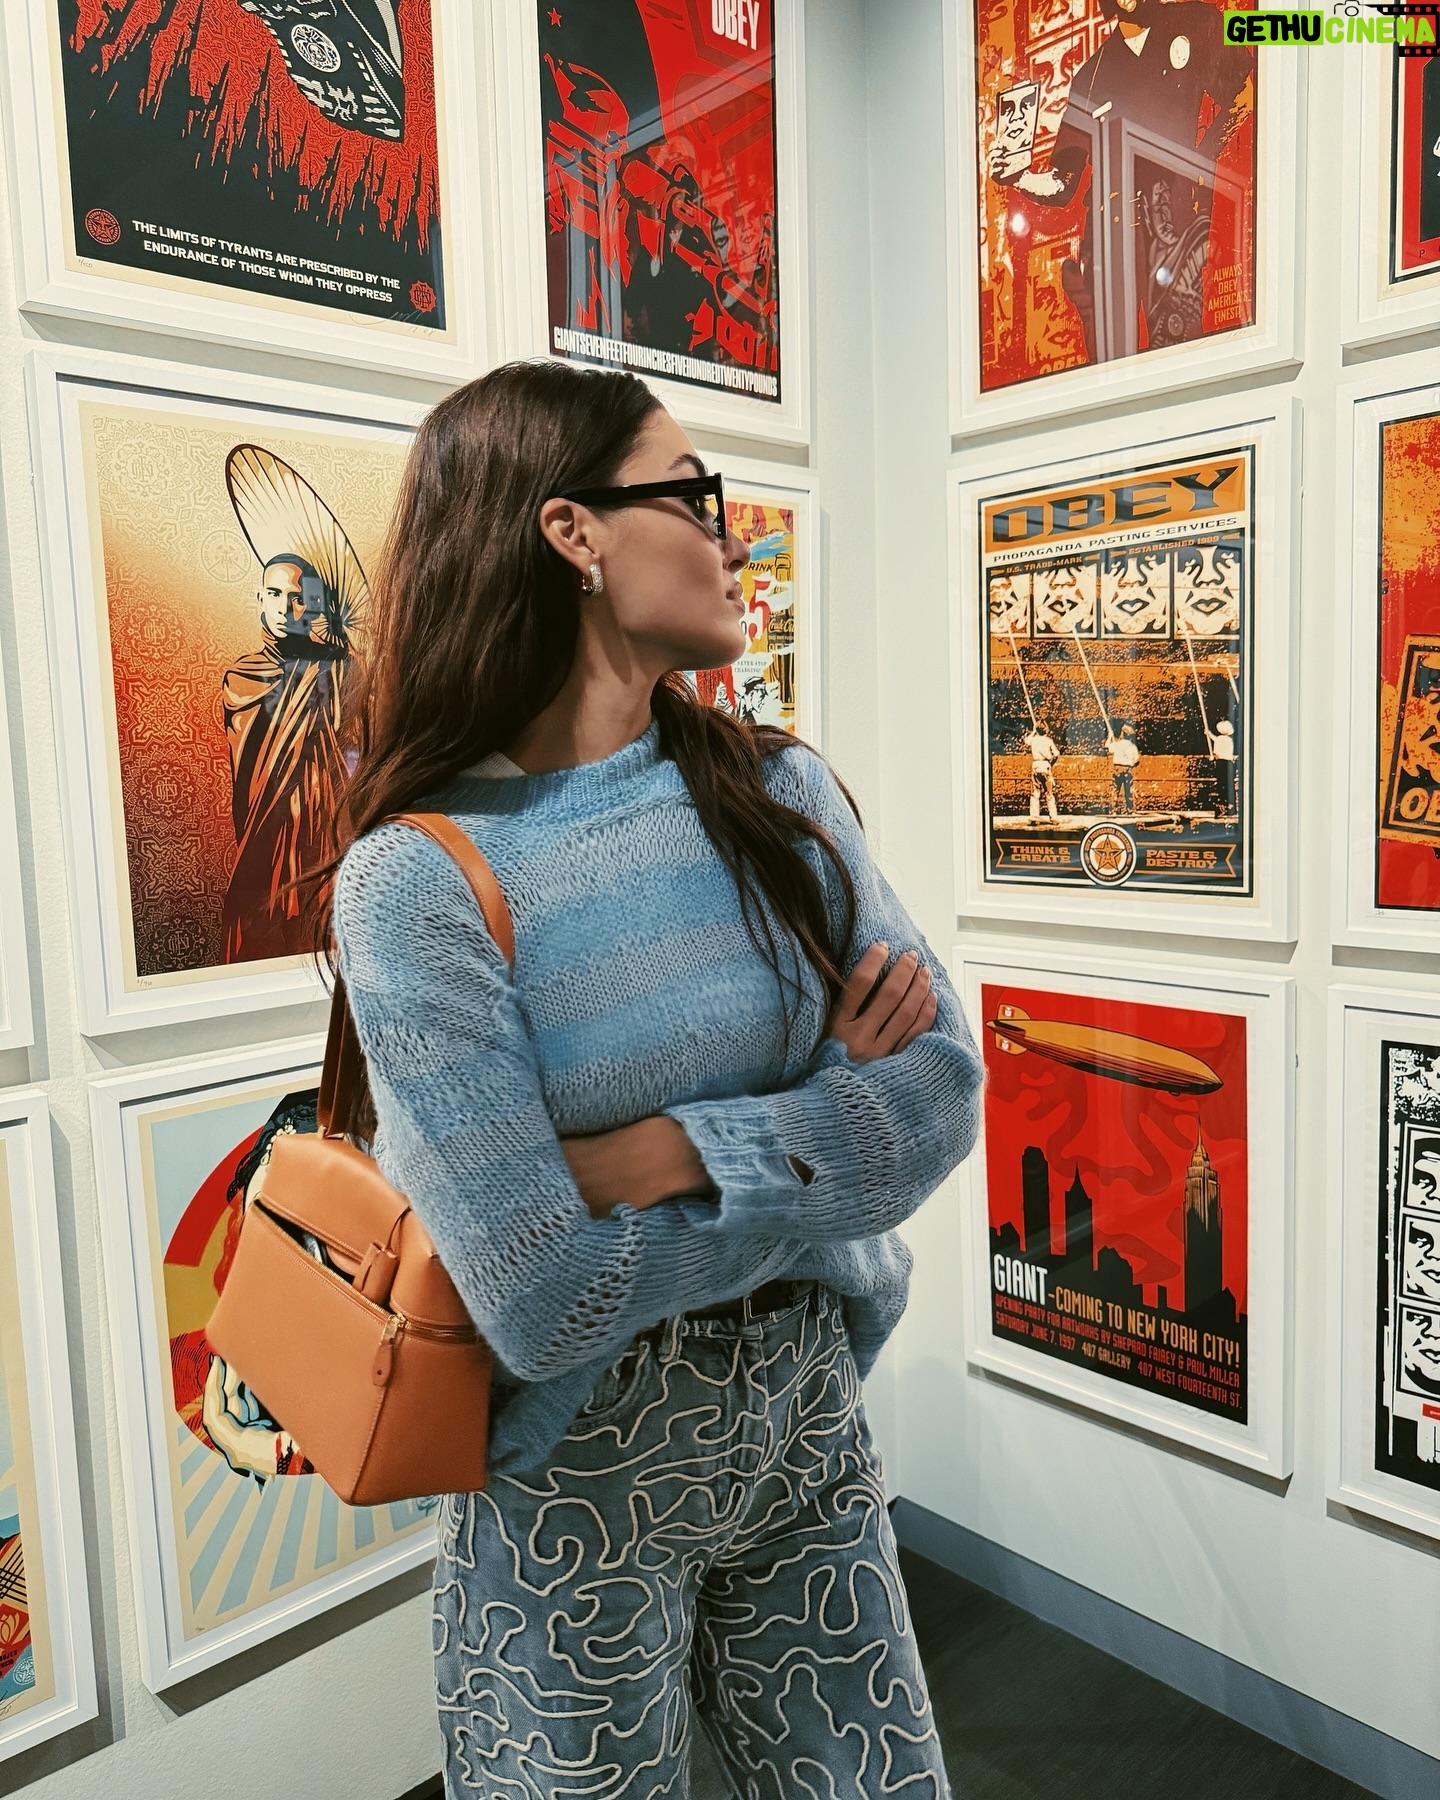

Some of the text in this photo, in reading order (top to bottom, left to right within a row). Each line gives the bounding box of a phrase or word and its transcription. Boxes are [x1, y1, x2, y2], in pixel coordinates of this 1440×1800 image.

[712, 0, 760, 51] OBEY
[132, 220, 401, 290] THE LIMITS OF TYRANTS ARE PRESCRIBED BY THE
[143, 239, 393, 303] ENDURANCE OF THOSE WHOM THEY OPPRESS
[1213, 263, 1243, 282] ALWAYS
[1218, 278, 1238, 295] OBEY
[1208, 289, 1248, 311] AMERICA'S
[1214, 305, 1242, 326] FINEST!
[992, 465, 1239, 544] OBEY
[993, 517, 1238, 562] PROPAGANDA PASTING SERVICES
[1128, 539, 1195, 555] ESTABLISHED
[1006, 565, 1023, 574] U.S.
[1010, 845, 1071, 855] THINK &
[1010, 853, 1071, 864] CREATE
[1146, 849, 1217, 861] PASTE &
[1146, 859, 1218, 870] DESTROY
[994, 1253, 1048, 1306] GIANT
[1106, 1302, 1123, 1330] TO
[1127, 1308, 1156, 1341] NEW
[1160, 1318, 1198, 1355] YORK
[1203, 1332, 1240, 1368] CITY!
[995, 1293, 1240, 1388] OPENING PARTY FOR ARTWORKS BY SHEPARD FAIREY & PAUL MILLER
[995, 1311, 1029, 1335] SATURDAY
[1030, 1323, 1049, 1343] JUNE
[1059, 1332, 1076, 1351] 1997
[1098, 1347, 1131, 1370] GALLERY
[1137, 1361, 1153, 1377] 407
[1155, 1366, 1176, 1386] WEST
[1177, 1374, 1228, 1405] FOURTEENTH
